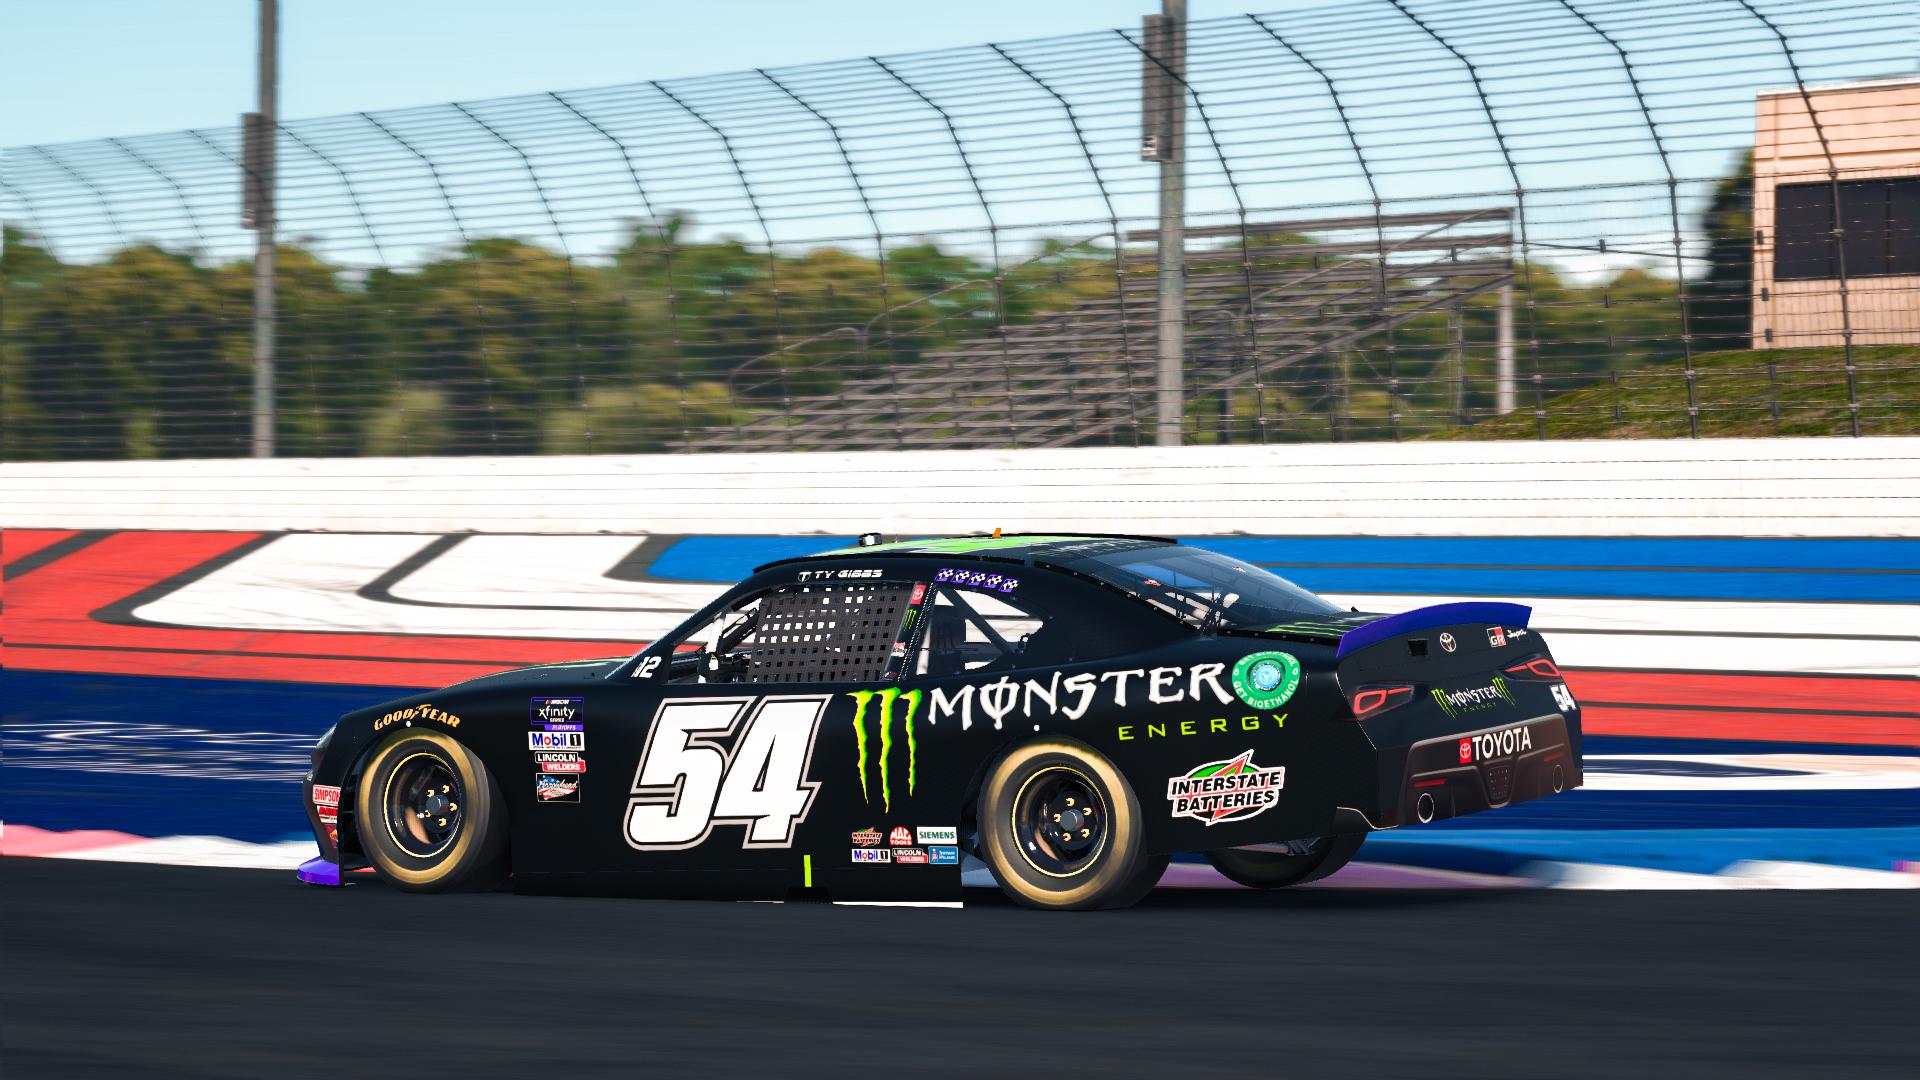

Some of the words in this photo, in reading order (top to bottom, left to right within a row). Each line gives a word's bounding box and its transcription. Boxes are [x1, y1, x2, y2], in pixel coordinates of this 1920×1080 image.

[815, 570, 835, 579] TY
[838, 569, 883, 578] GIBBS
[1490, 635, 1505, 646] GR
[1247, 679, 1299, 708] BIOETHANOL
[1549, 684, 1577, 712] 54
[538, 705, 576, 720] xfinity
[1118, 713, 1289, 741] ENERGY
[532, 733, 567, 747] Mobil
[1471, 725, 1532, 761] TOYOTA
[537, 754, 576, 762] LINCOLN
[546, 763, 581, 771] WELDERS
[623, 693, 834, 851] 54
[1171, 771, 1281, 795] INTERSTATE
[1177, 790, 1275, 813] BATTERIES
[891, 827, 911, 840] MAC
[919, 831, 955, 840] SIEMENS
[854, 850, 878, 860] Mobil
[893, 849, 922, 857] LINCOLN
